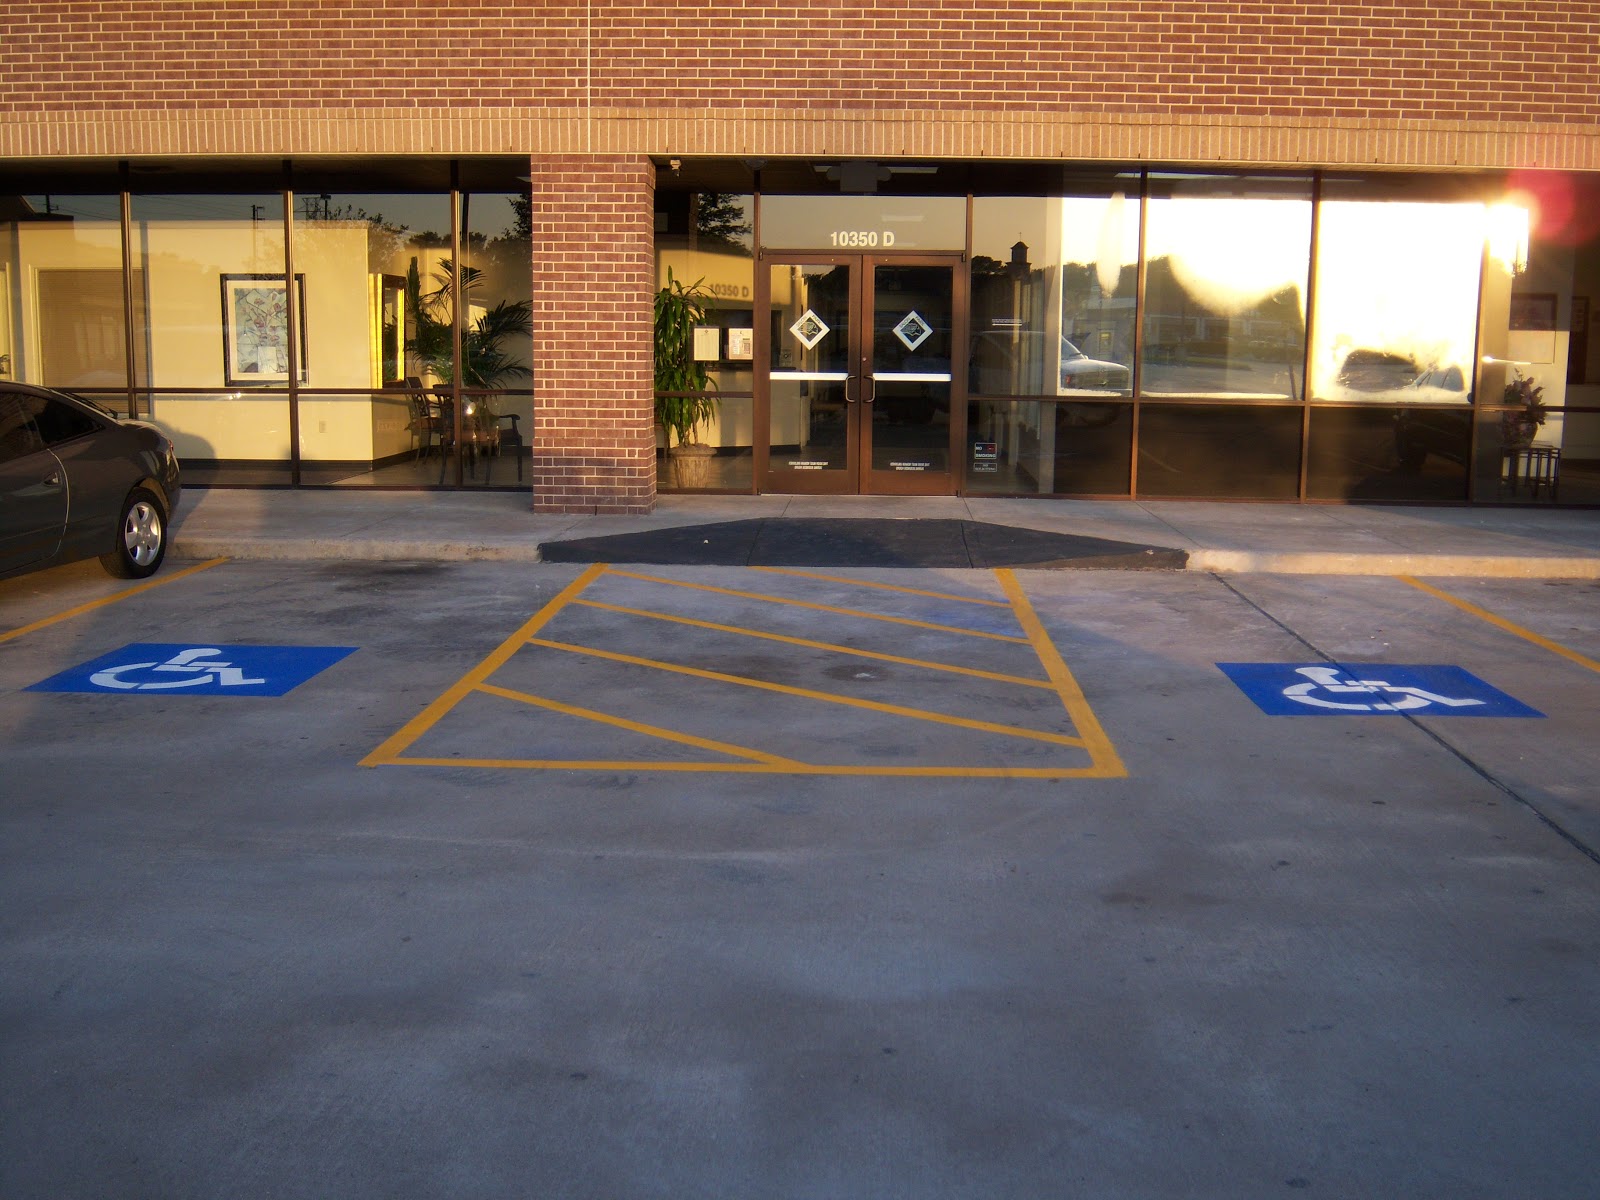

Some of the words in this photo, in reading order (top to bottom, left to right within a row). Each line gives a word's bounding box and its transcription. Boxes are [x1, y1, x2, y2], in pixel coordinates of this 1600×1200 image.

[830, 231, 878, 247] 10350
[883, 231, 895, 247] D
[709, 283, 739, 297] 10350
[742, 285, 749, 298] D
